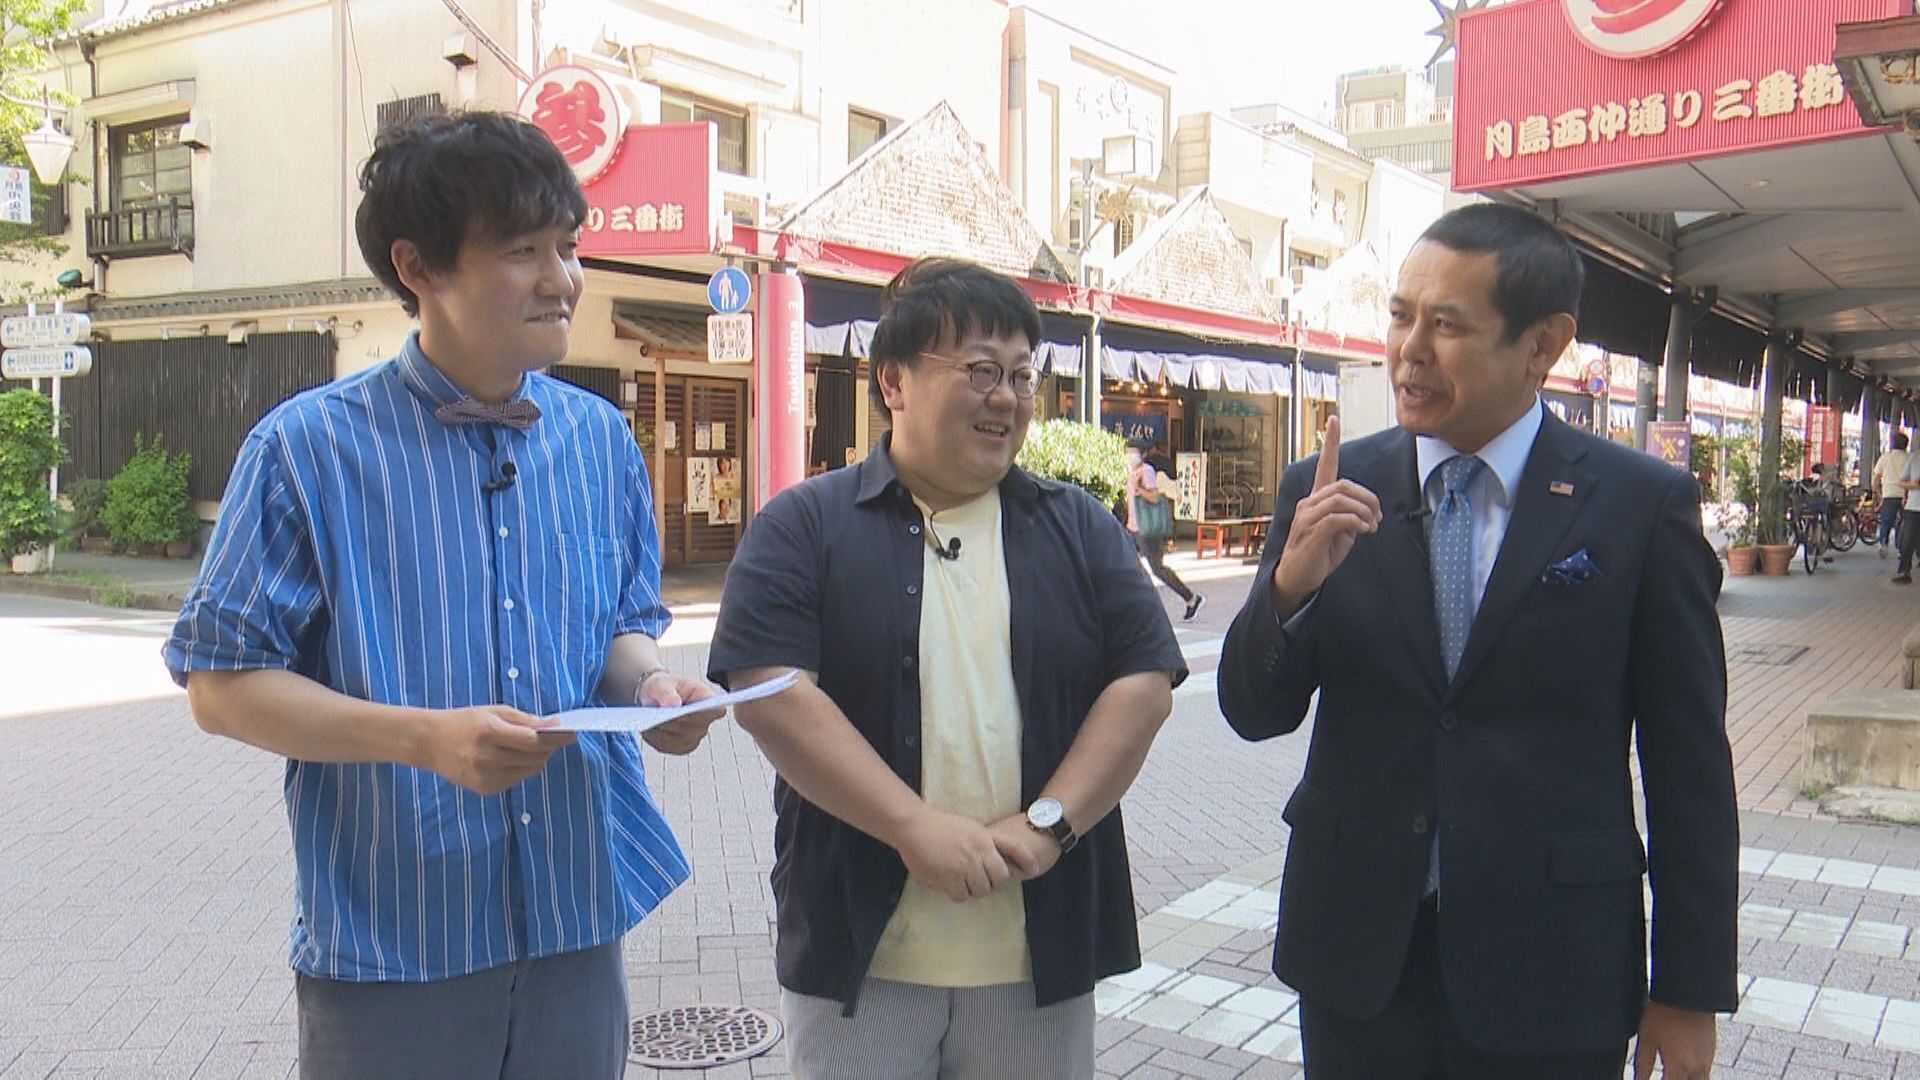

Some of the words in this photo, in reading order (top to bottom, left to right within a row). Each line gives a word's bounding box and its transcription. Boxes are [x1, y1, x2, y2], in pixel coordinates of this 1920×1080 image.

[1484, 63, 1845, 161] 月島西仲通り三番街
[788, 300, 799, 312] 3
[788, 320, 801, 415] Tsukishima
